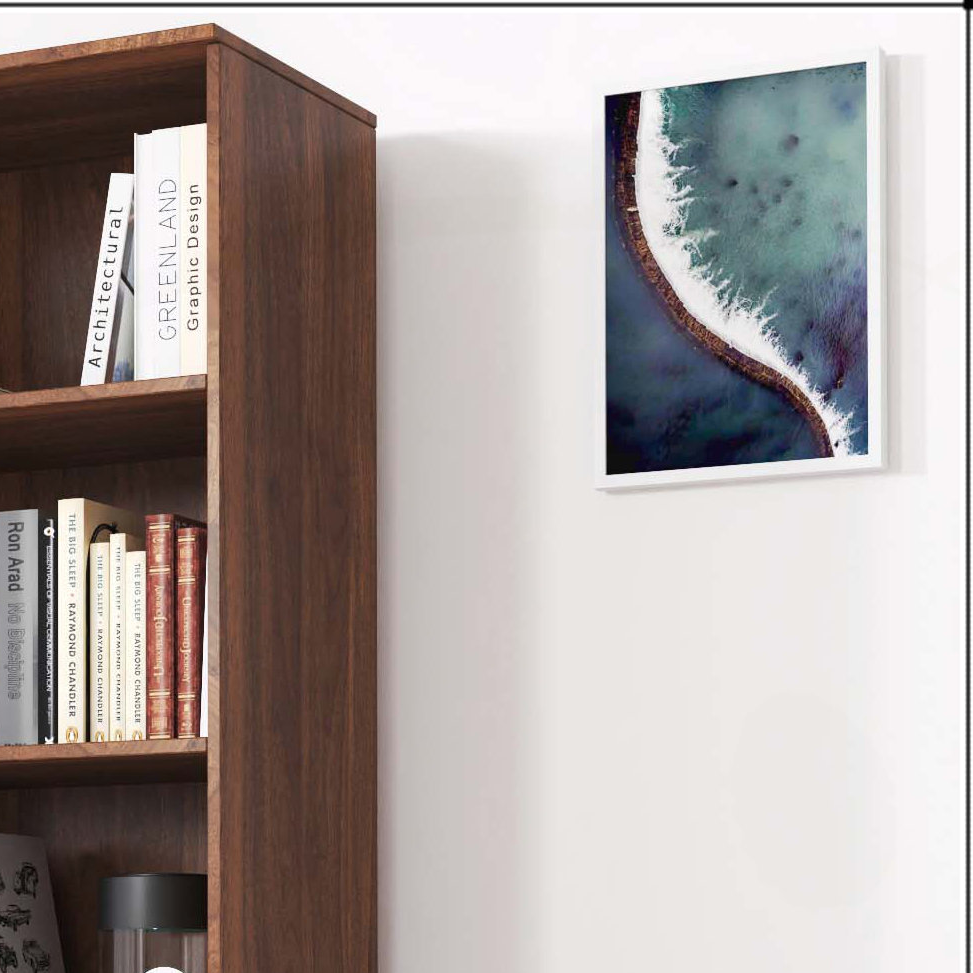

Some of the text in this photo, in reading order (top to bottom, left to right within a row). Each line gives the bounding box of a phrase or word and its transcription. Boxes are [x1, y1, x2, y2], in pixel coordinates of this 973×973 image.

[88, 206, 124, 368] Architectural
[159, 179, 177, 341] GREENLAND
[187, 183, 202, 331] Graphic Design
[4, 521, 26, 700] Ron Arad No Discipline
[68, 514, 76, 717] THE BIG SLEEP RAYMOND CHANDLER
